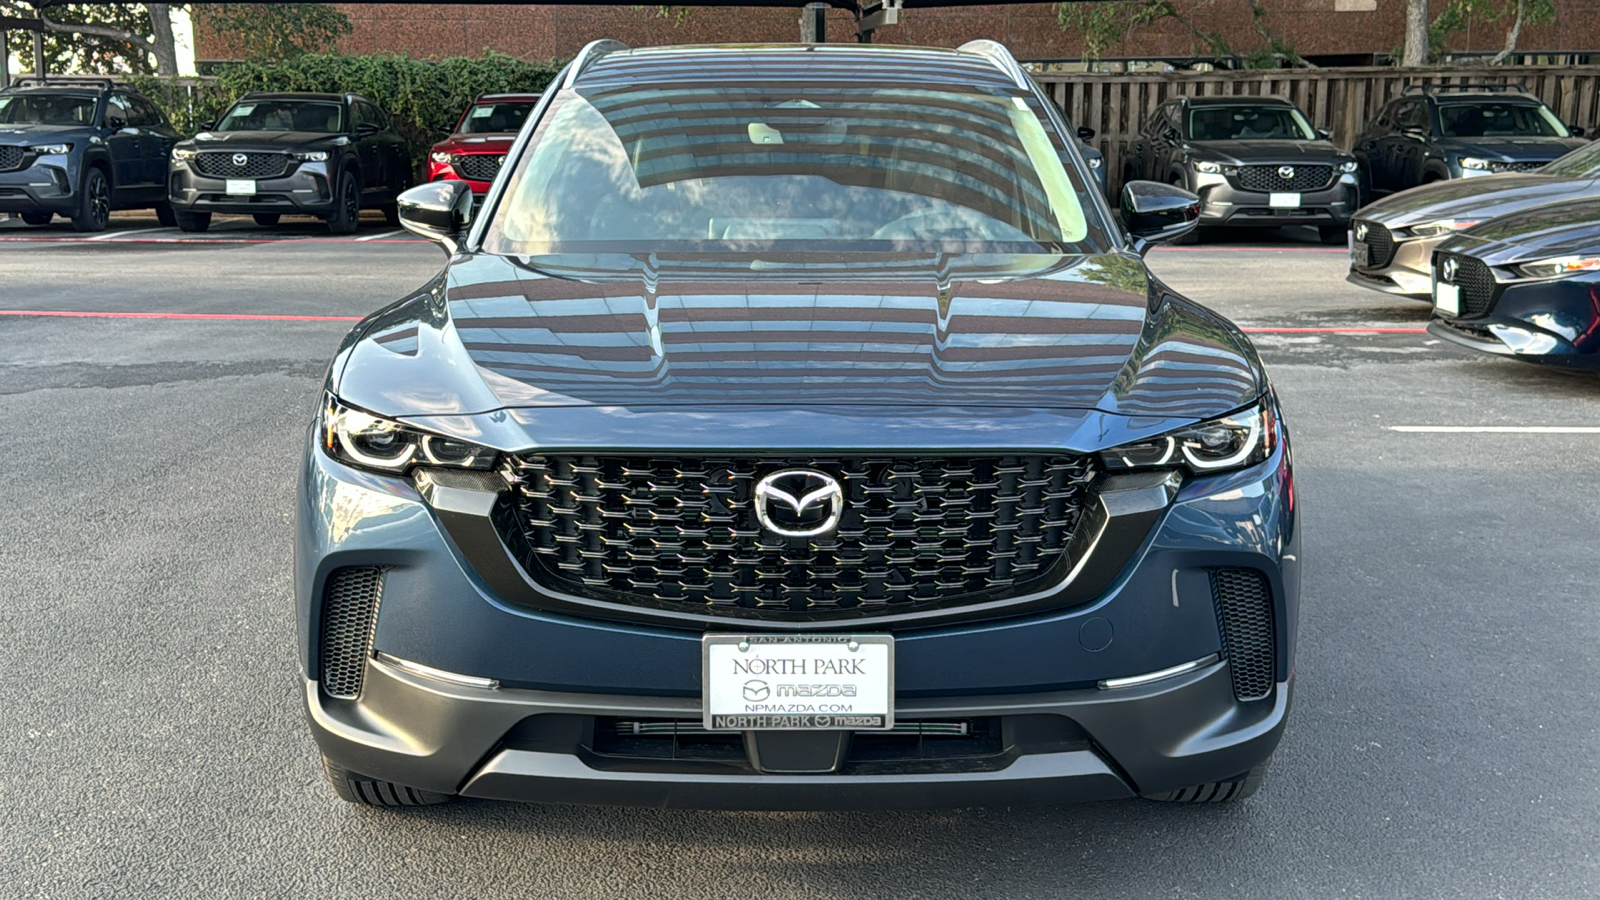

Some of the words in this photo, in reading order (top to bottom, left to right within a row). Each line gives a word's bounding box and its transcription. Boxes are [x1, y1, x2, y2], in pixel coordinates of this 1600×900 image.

[732, 658, 808, 675] NORTH
[814, 658, 866, 675] PARK
[776, 684, 857, 697] mazda
[745, 704, 853, 712] NPMAZDA.COM
[715, 716, 767, 727] NORTH
[771, 716, 811, 727] PARK
[834, 716, 882, 726] mazda
